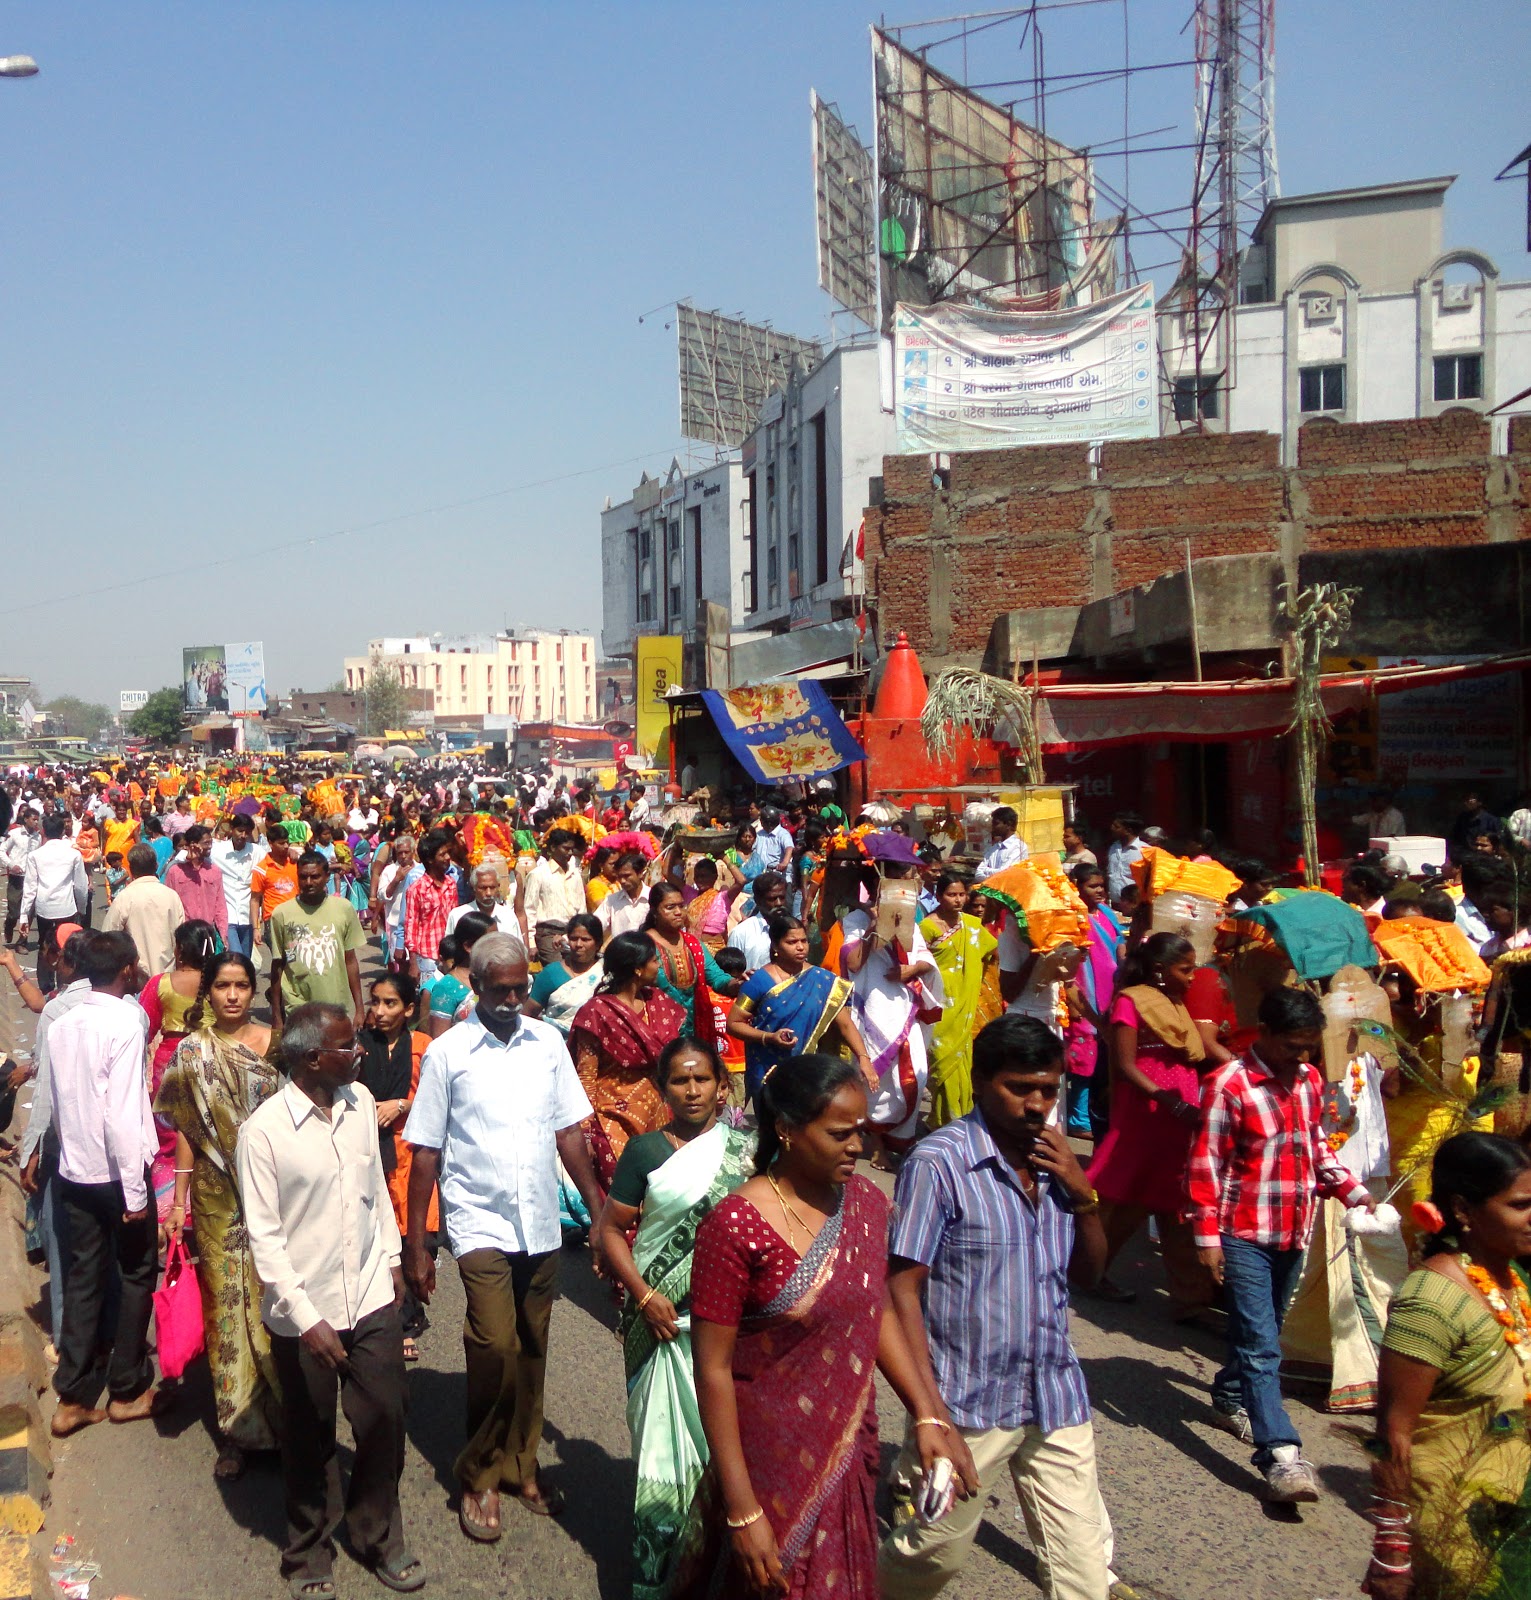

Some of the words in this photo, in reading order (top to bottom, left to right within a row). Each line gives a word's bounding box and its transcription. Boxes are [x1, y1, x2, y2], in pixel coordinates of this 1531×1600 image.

[944, 355, 954, 368] ૧
[944, 382, 953, 394] ૨
[963, 404, 986, 418] પટેલ
[121, 692, 147, 702] CHITRA
